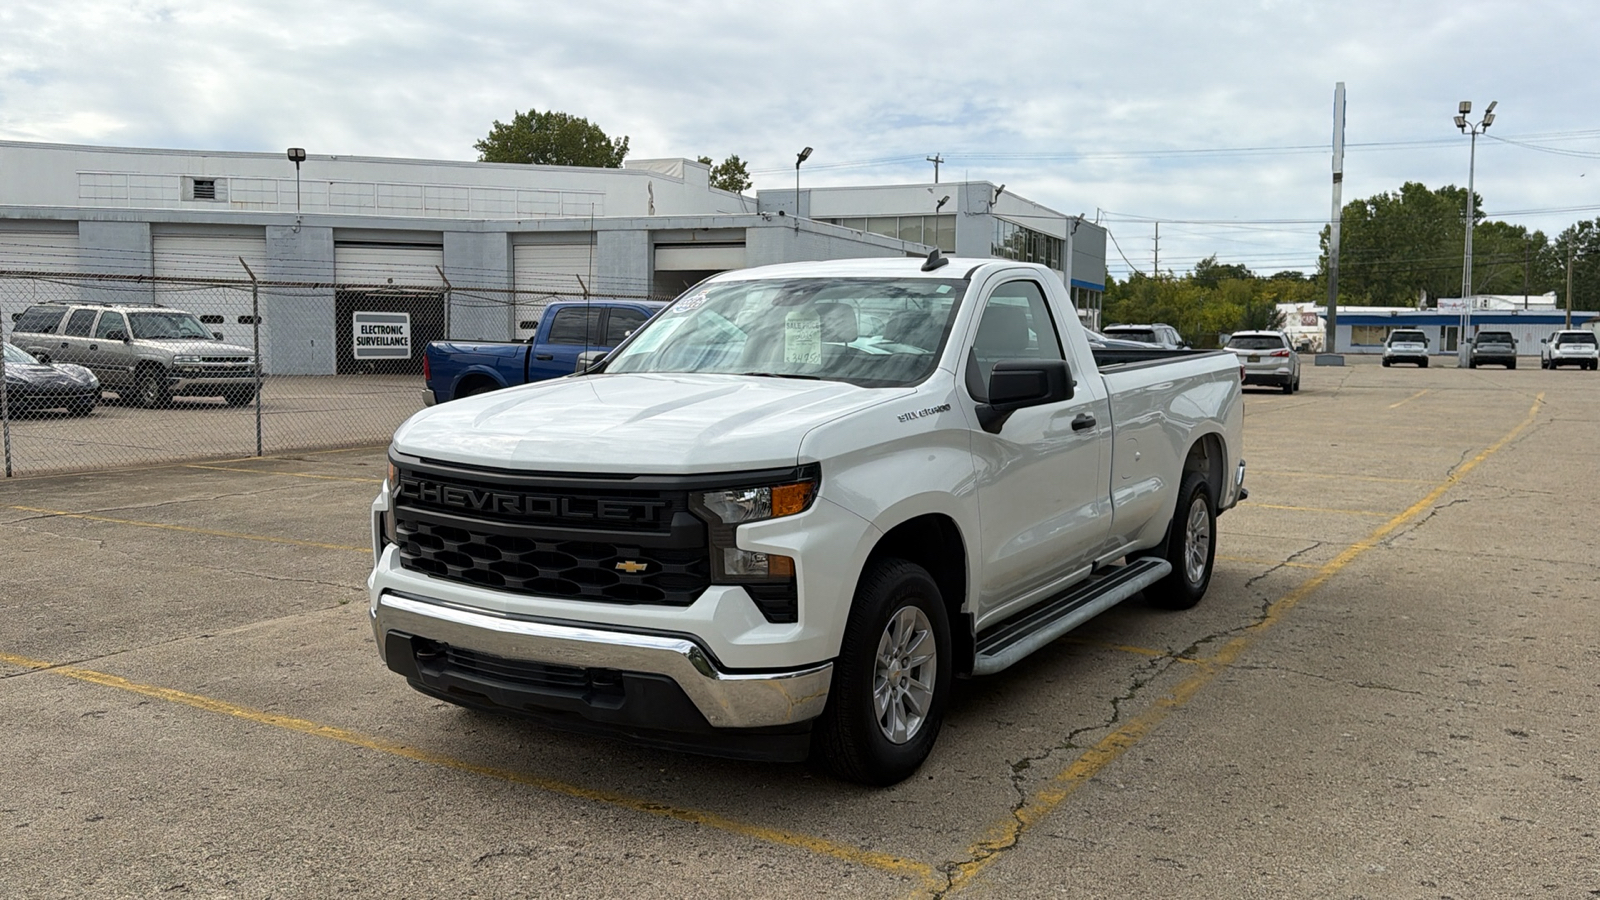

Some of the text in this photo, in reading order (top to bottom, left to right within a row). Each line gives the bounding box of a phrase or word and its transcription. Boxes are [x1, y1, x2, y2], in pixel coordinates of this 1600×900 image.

[361, 325, 403, 335] ELECTRONIC
[786, 322, 801, 330] SALE
[356, 336, 408, 346] SURVEILLANCE
[897, 403, 951, 423] SILVERADO
[399, 478, 667, 522] CHEVROLET
